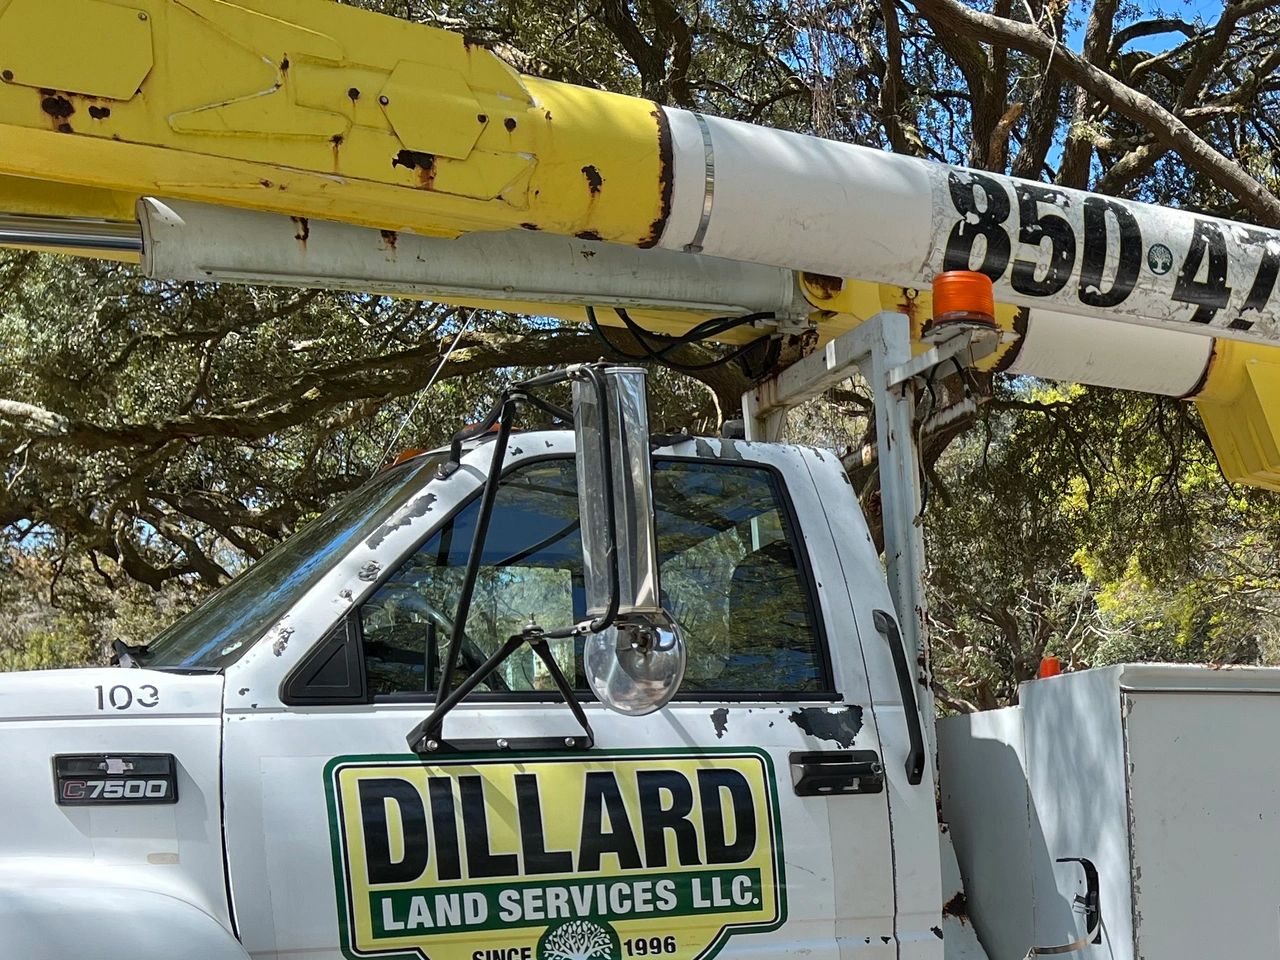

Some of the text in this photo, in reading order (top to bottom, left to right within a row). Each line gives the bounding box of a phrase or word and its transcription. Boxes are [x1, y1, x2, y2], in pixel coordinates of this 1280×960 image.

[943, 170, 1143, 307] 850
[95, 684, 160, 711] 103
[62, 780, 168, 799] C7500
[357, 768, 758, 885] DILLARD
[381, 875, 760, 932] LAND SERVICES LLC.
[623, 935, 676, 957] 1996
